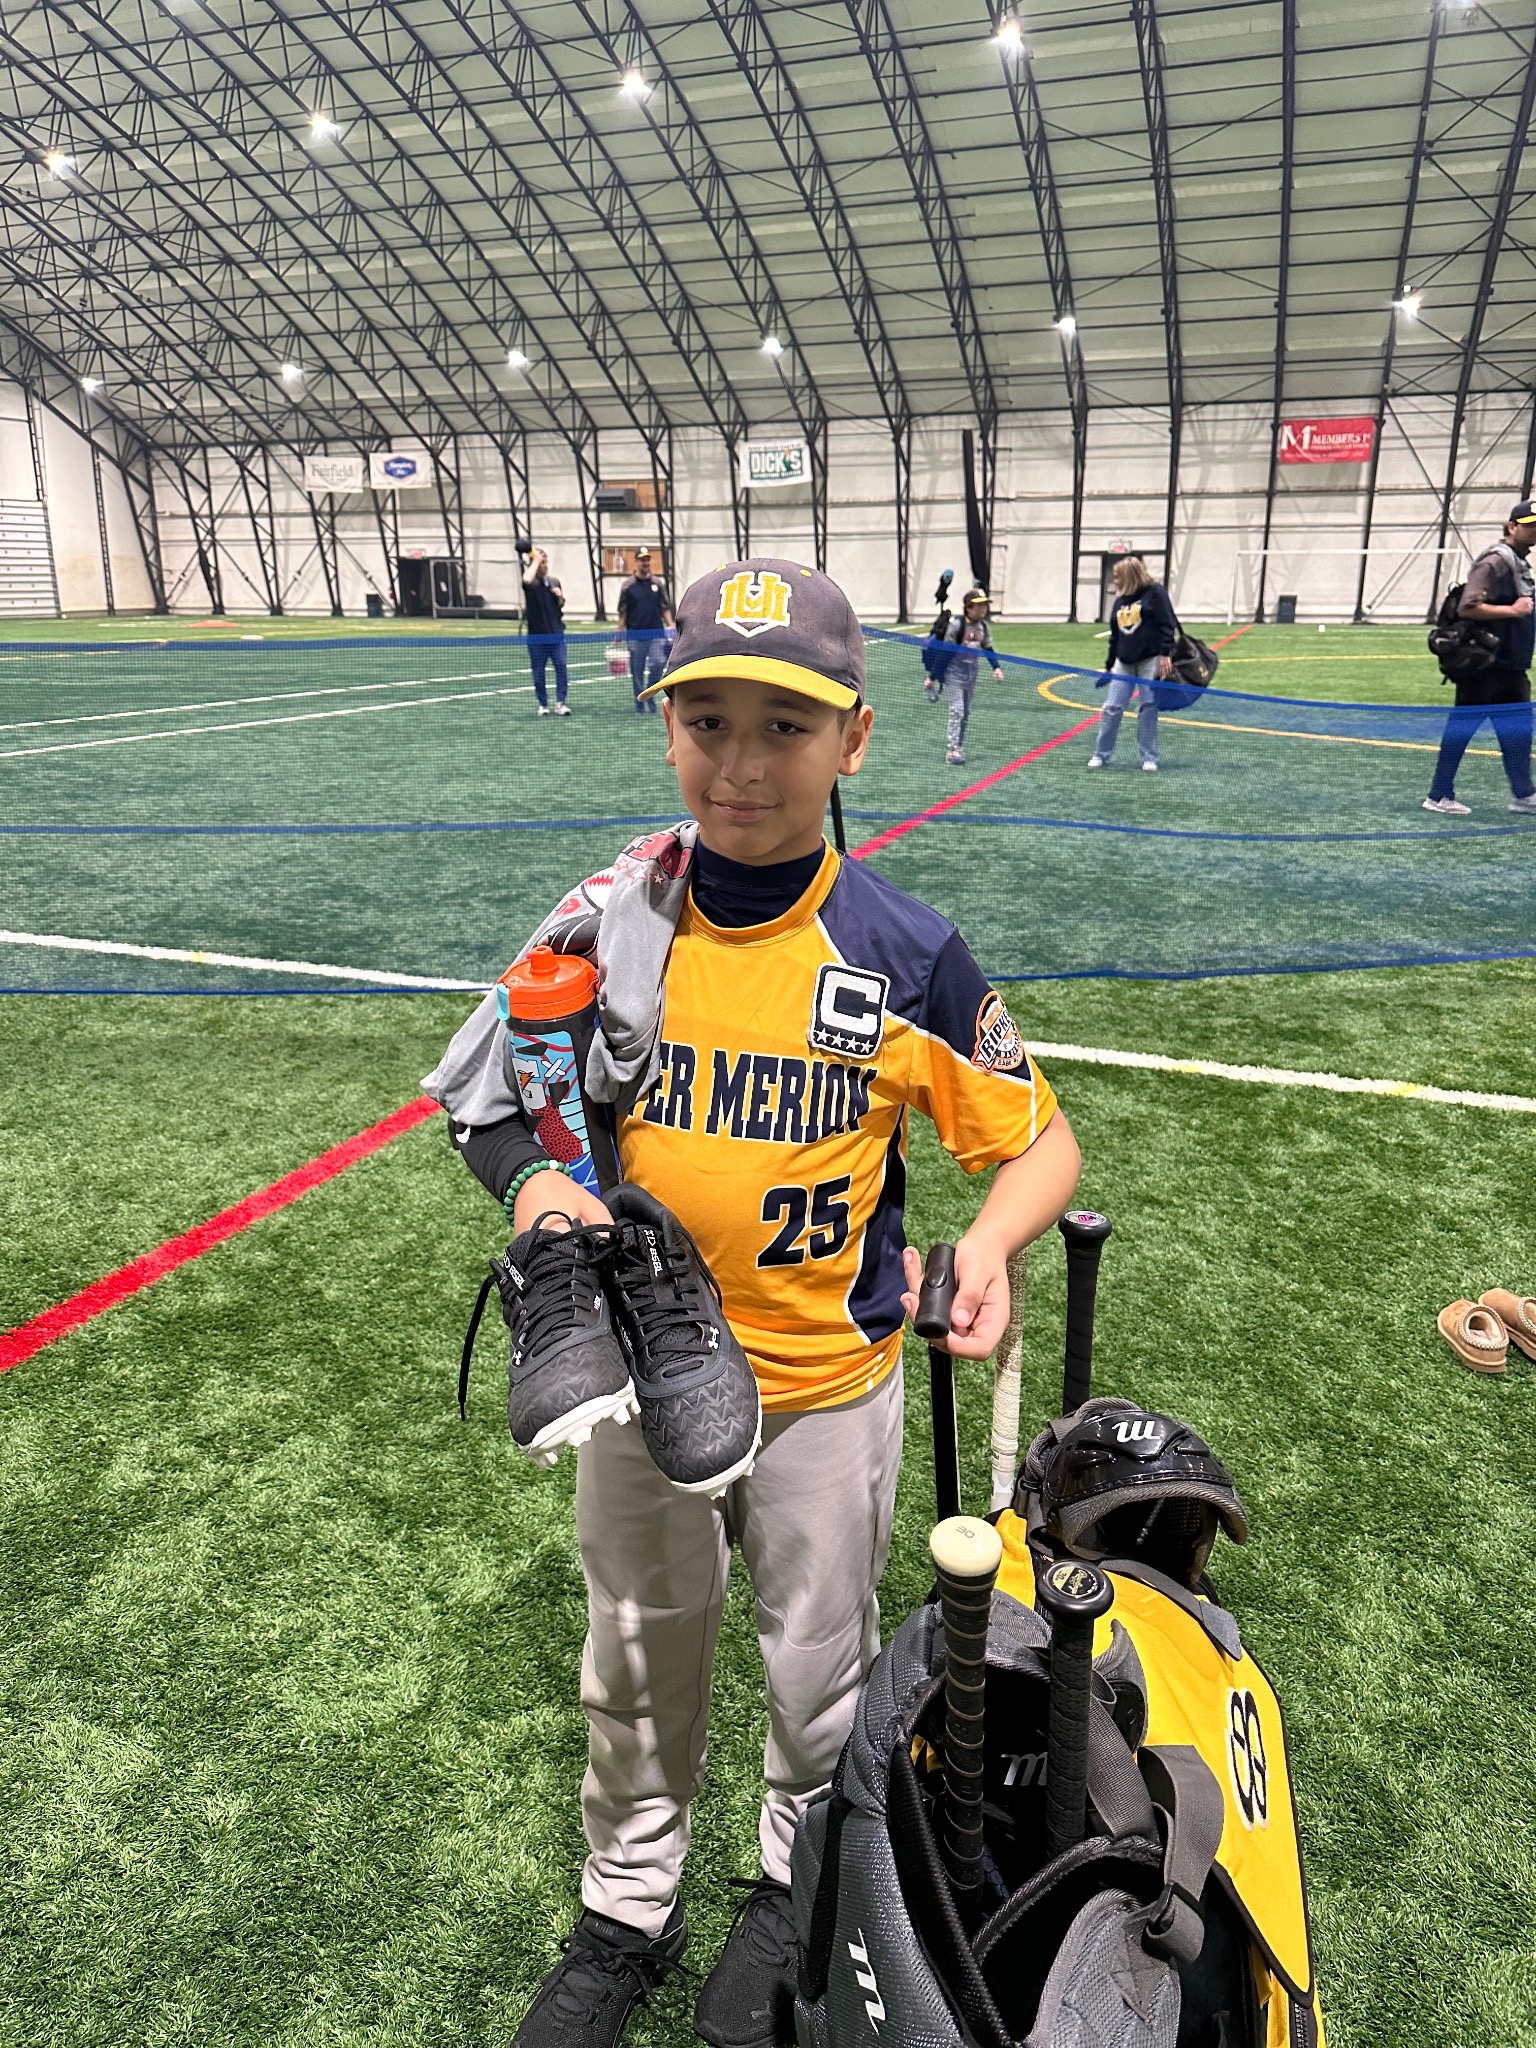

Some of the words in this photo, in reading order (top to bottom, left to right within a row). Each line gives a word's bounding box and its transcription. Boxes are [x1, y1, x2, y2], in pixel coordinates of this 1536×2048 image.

[1311, 433, 1361, 444] MEMBERS
[311, 463, 353, 477] Fairfield
[751, 450, 802, 473] DICK'S
[820, 970, 882, 1036] C
[705, 1049, 878, 1144] MERION
[757, 1175, 852, 1267] 25
[650, 1248, 663, 1277] BSBL
[509, 1265, 525, 1290] BSBL
[955, 1525, 975, 1539] 30
